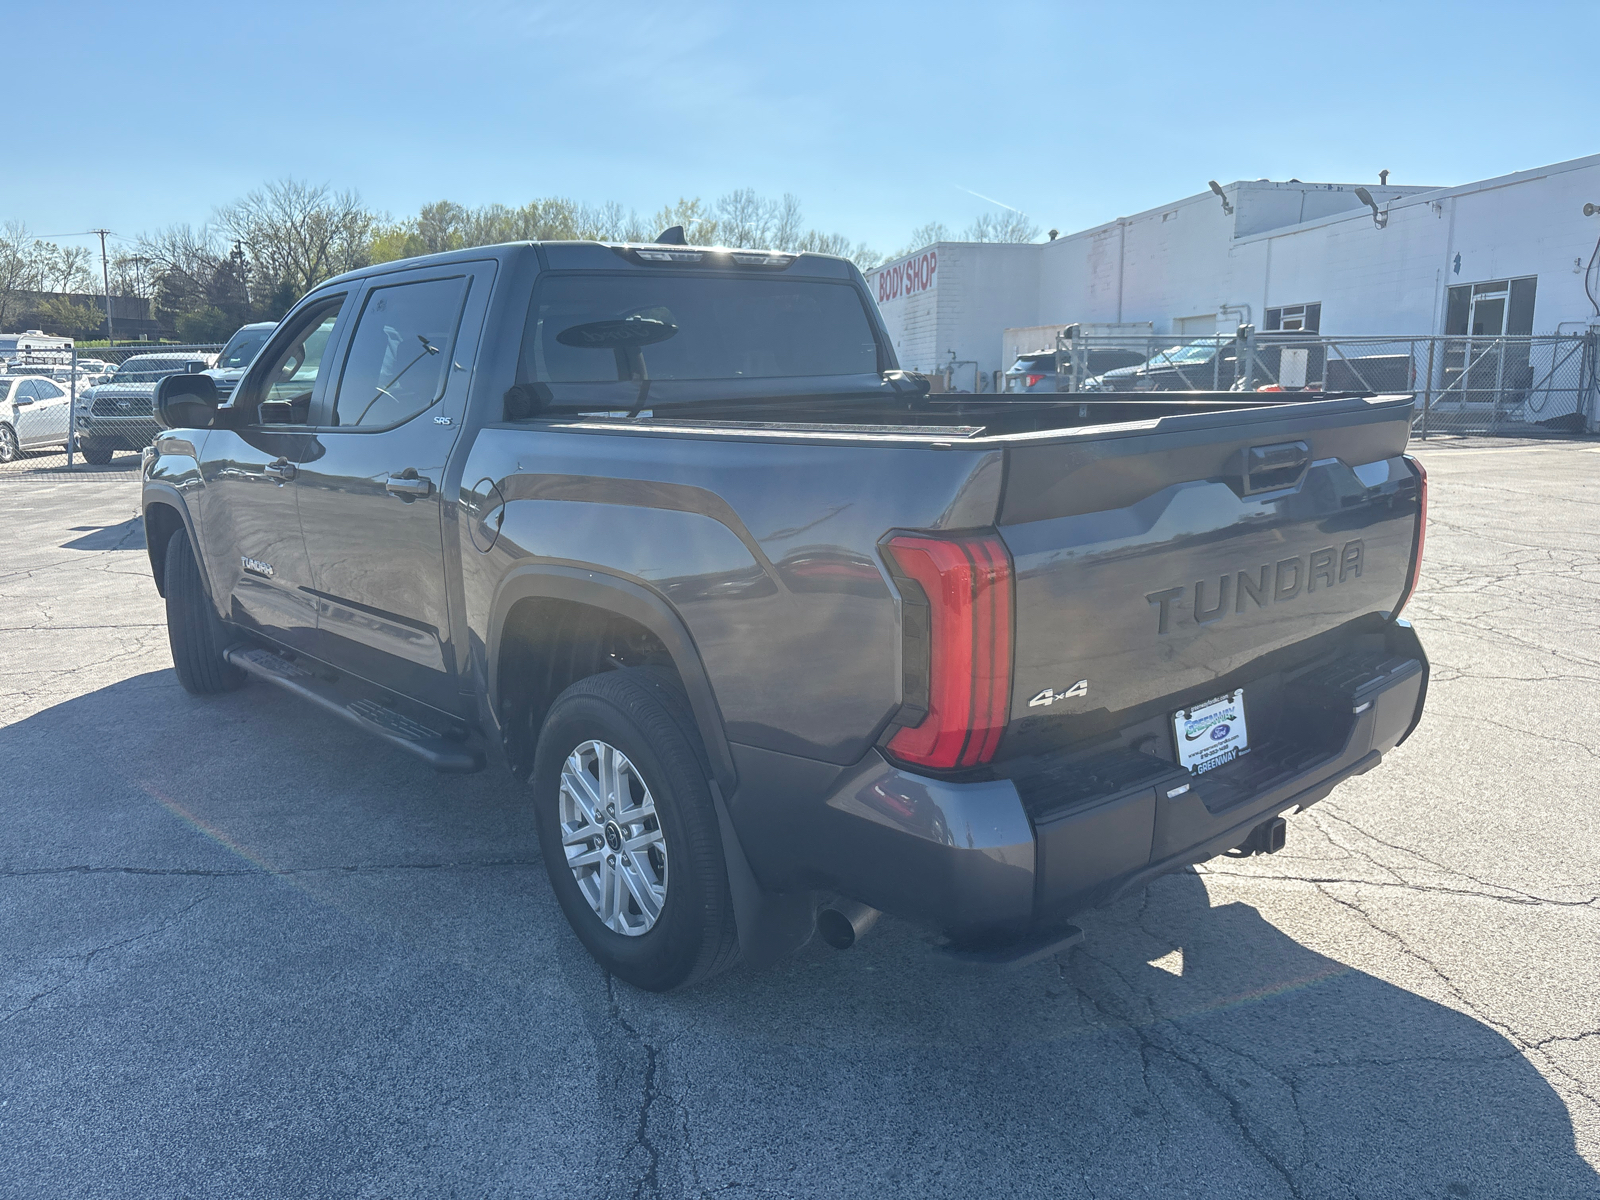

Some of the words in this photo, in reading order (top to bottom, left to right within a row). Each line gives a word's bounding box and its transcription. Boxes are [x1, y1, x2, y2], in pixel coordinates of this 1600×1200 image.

[241, 556, 274, 575] TUNDRA
[1144, 537, 1365, 635] TUNDRA
[1213, 726, 1228, 739] Ford
[1197, 749, 1237, 775] GREENWAY
